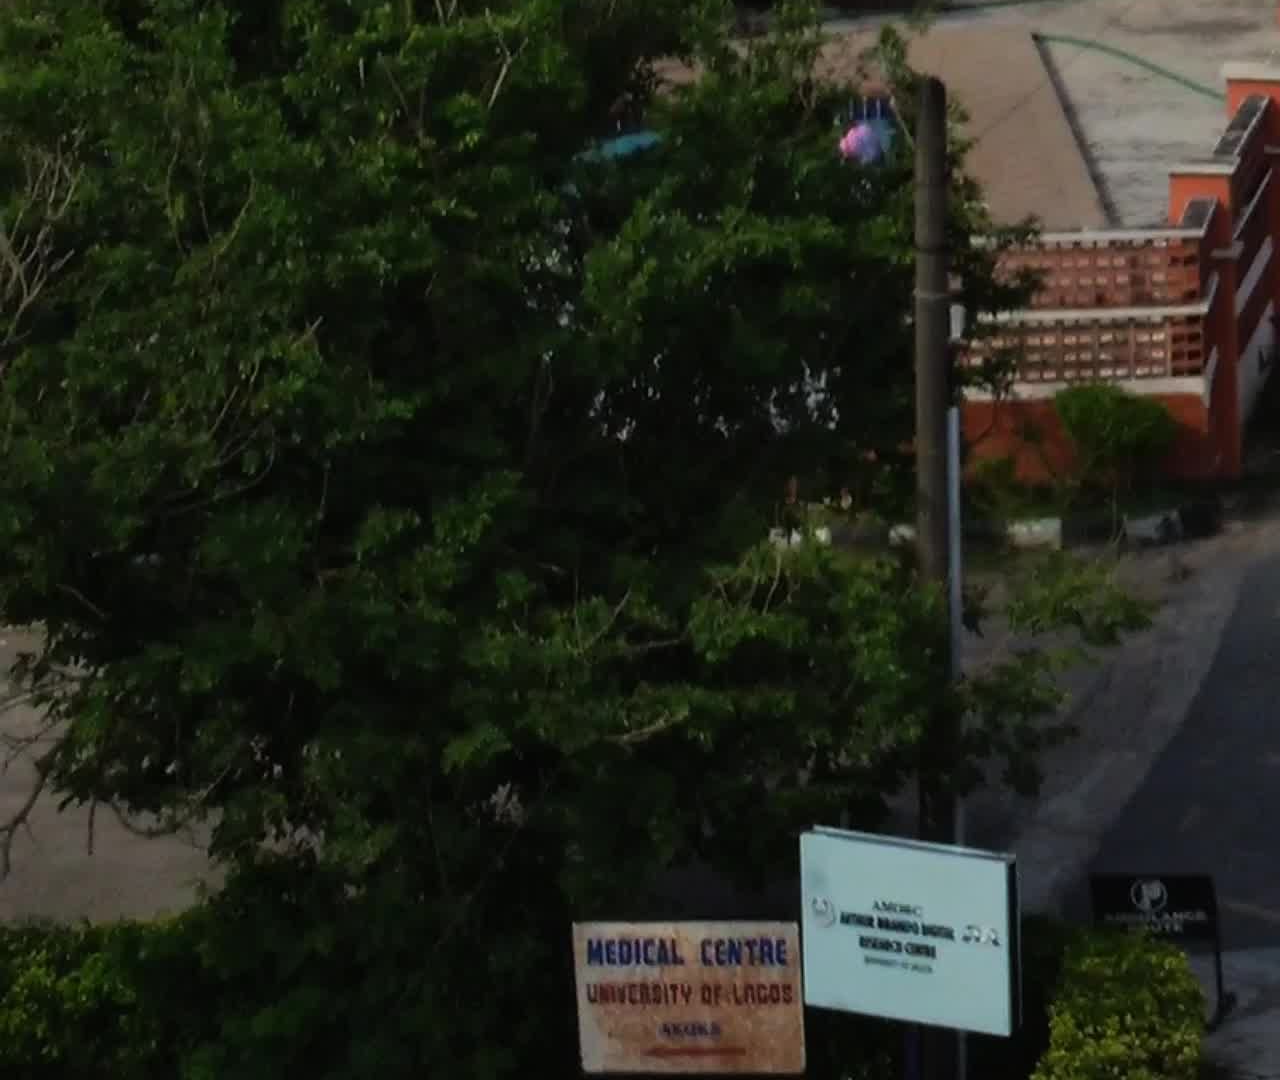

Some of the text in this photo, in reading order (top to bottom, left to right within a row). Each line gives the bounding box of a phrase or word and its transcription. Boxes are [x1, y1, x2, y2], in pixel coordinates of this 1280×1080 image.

[586, 938, 787, 966] MEDICAL CENTRE
[586, 982, 793, 1006] UNIVERSITY OF LAGOS
